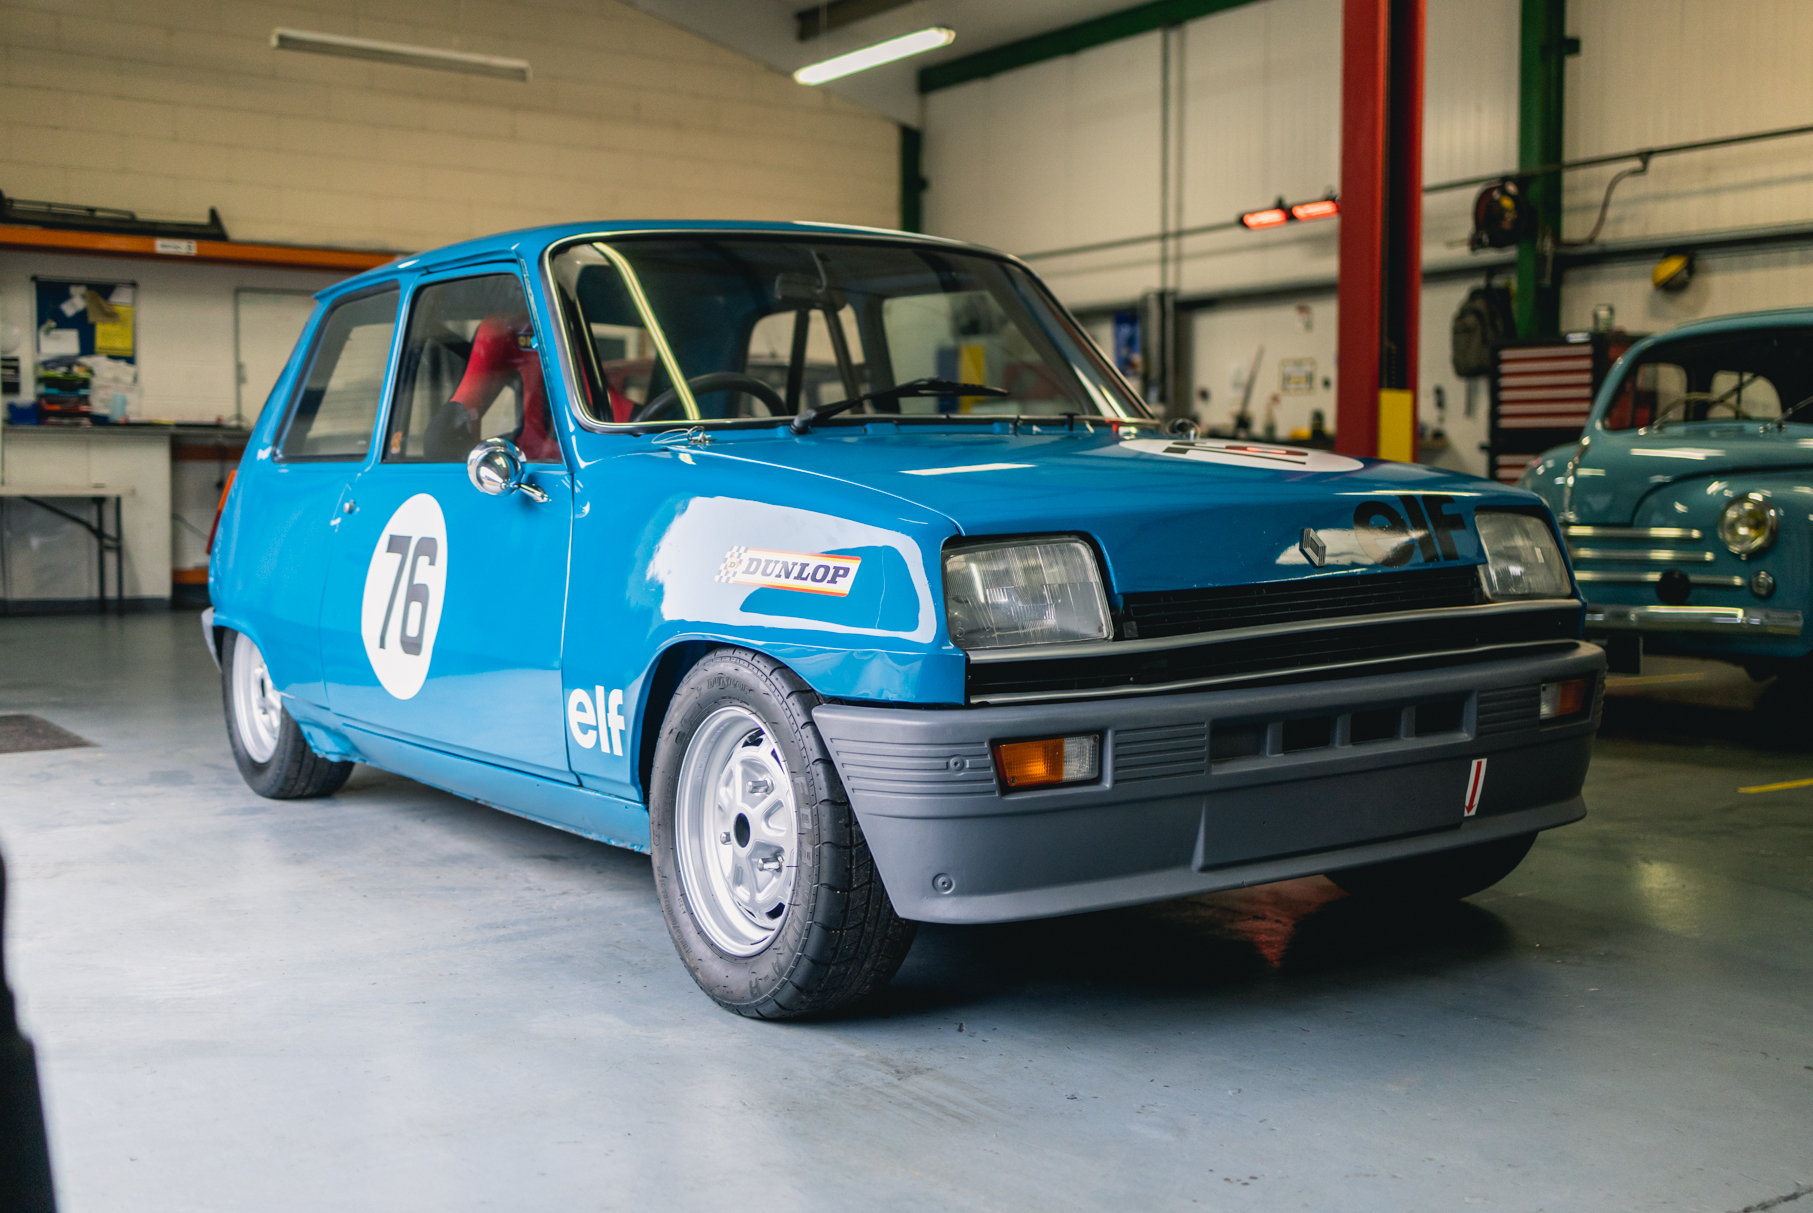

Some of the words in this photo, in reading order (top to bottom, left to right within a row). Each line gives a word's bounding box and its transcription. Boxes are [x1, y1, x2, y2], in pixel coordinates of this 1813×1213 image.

[1353, 494, 1467, 568] elf
[379, 534, 438, 657] 76
[742, 557, 851, 584] DUNLOP
[567, 684, 626, 757] elf
